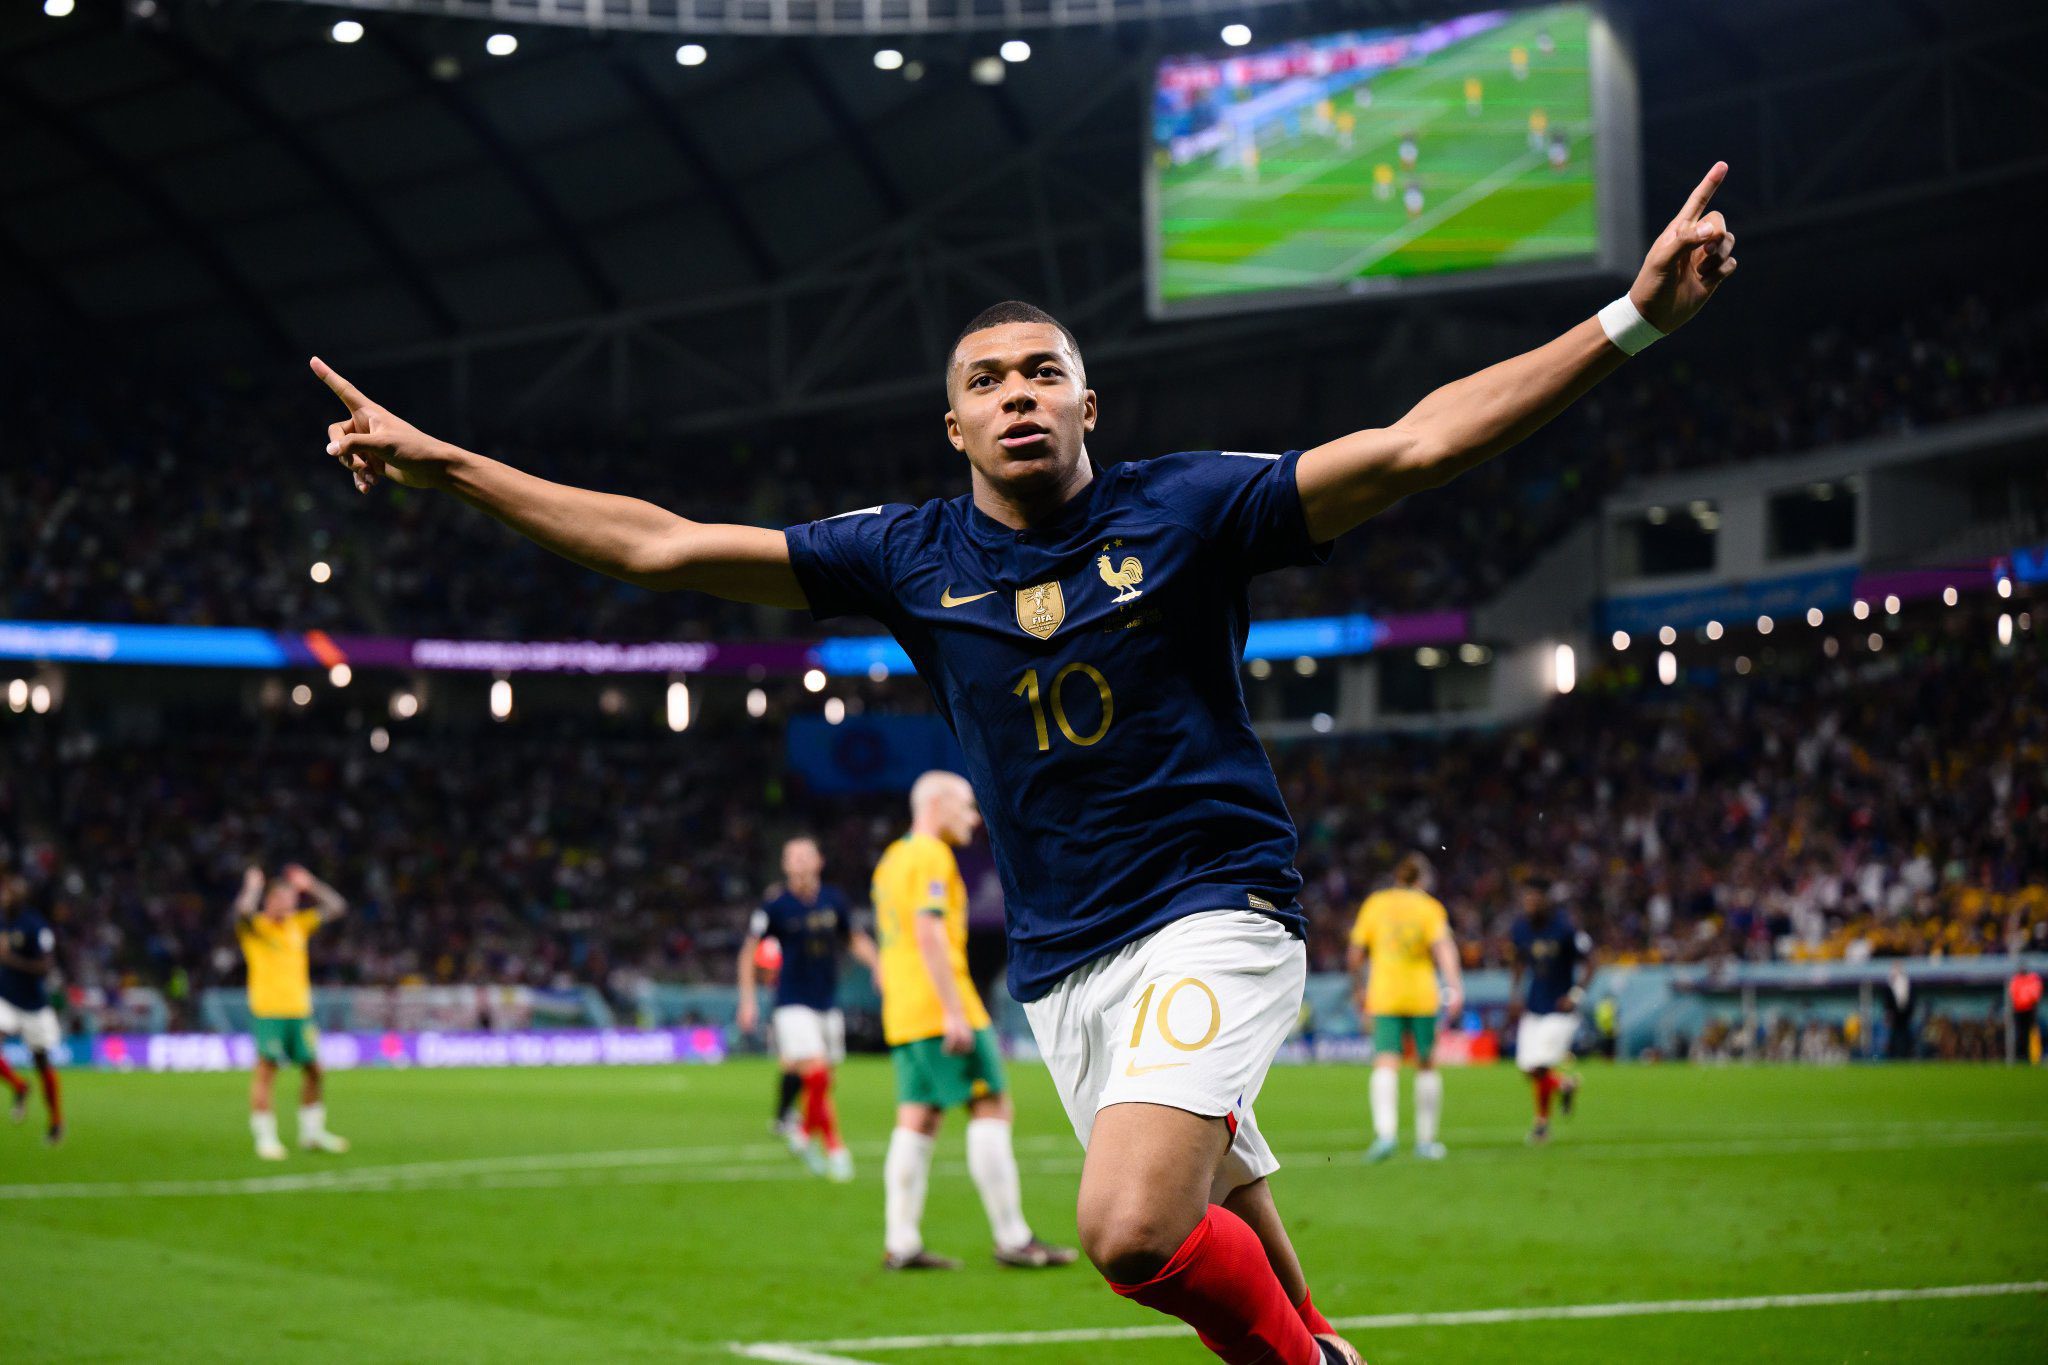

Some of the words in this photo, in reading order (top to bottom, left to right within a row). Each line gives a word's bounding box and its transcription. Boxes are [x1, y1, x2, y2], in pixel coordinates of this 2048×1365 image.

[1032, 614, 1052, 625] FIFA
[1012, 662, 1114, 751] 10
[1129, 977, 1221, 1051] 10
